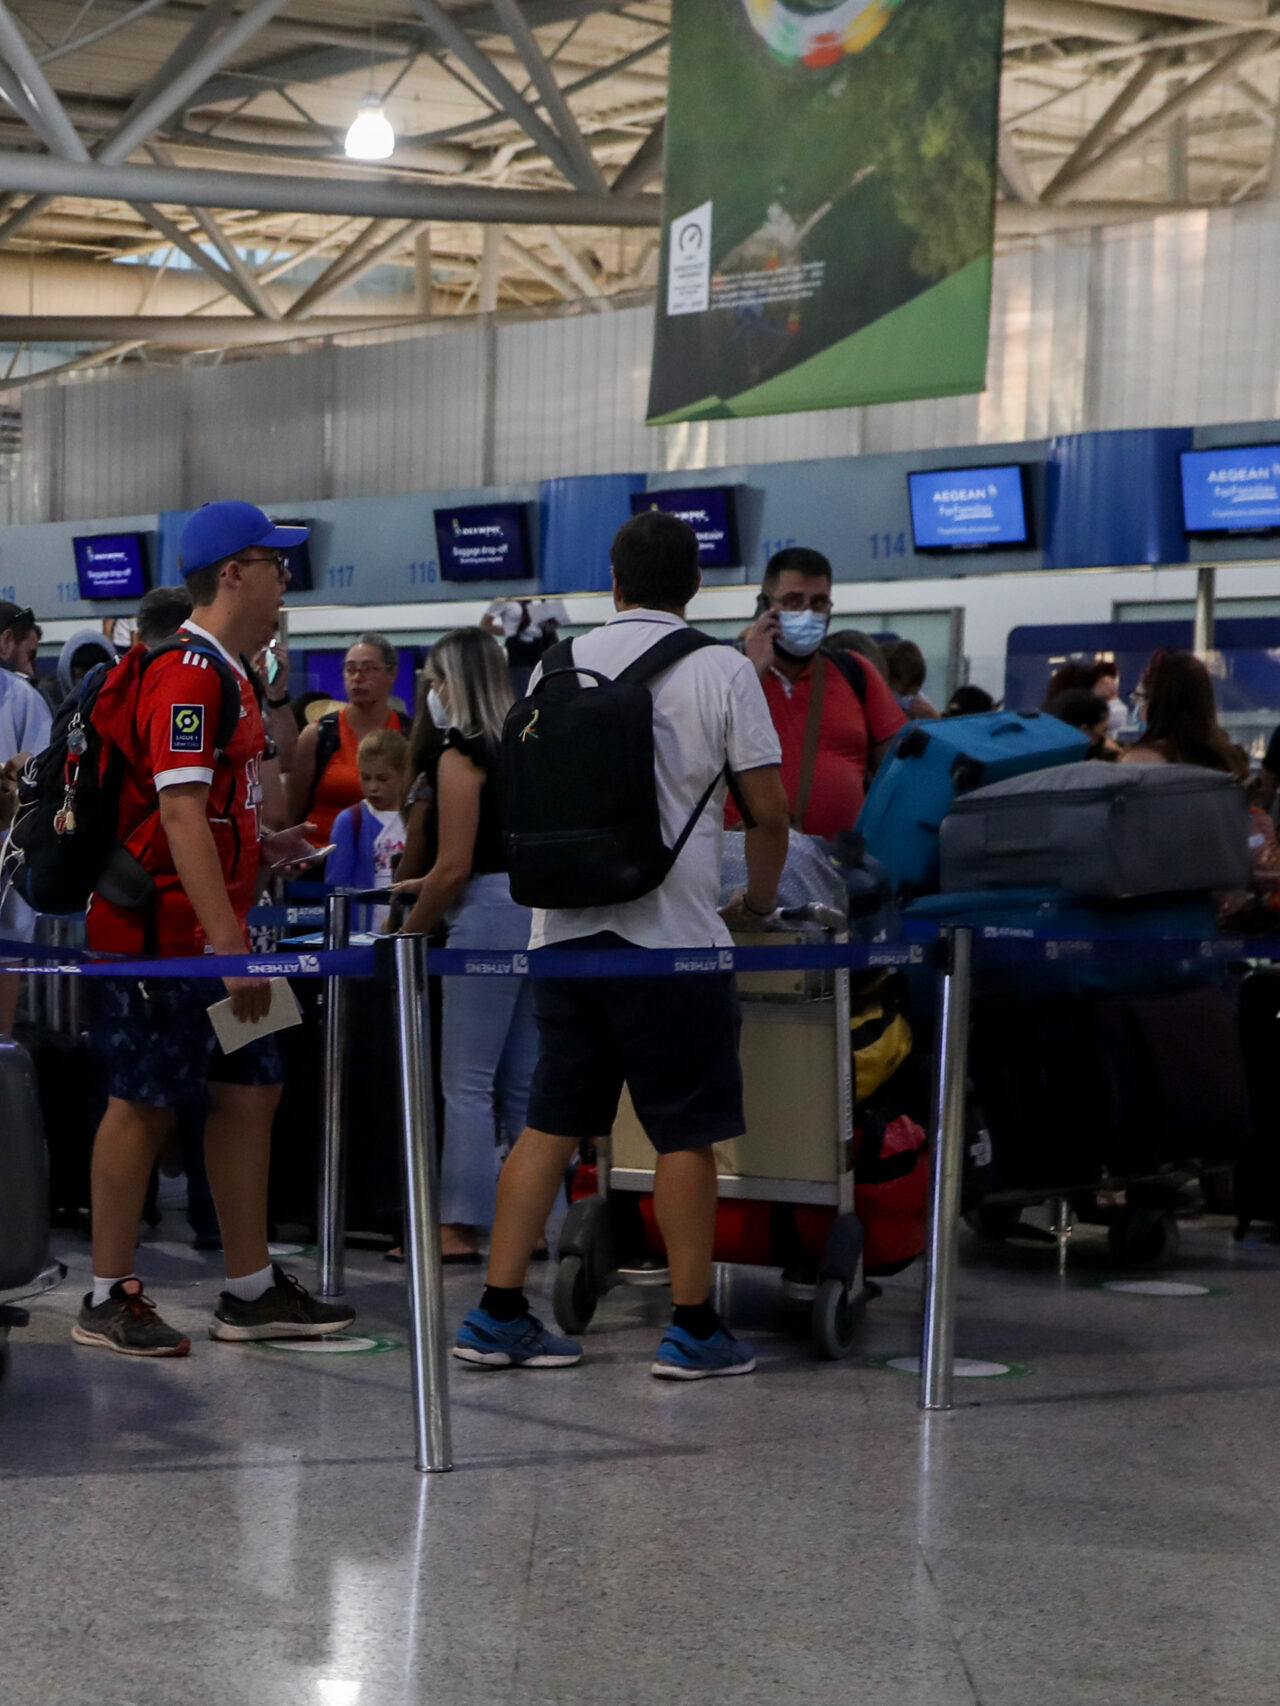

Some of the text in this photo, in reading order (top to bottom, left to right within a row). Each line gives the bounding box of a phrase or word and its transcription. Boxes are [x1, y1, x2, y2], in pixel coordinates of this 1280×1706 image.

[1207, 467, 1270, 483] AEGEAN
[932, 488, 987, 503] AEGEAN
[867, 532, 905, 559] 114
[328, 565, 355, 588] 117
[409, 561, 437, 585] 116
[298, 906, 325, 915] ATHEN
[247, 963, 300, 973] ATHENS
[465, 962, 512, 974] ATHENS
[675, 960, 718, 973] ATHENS
